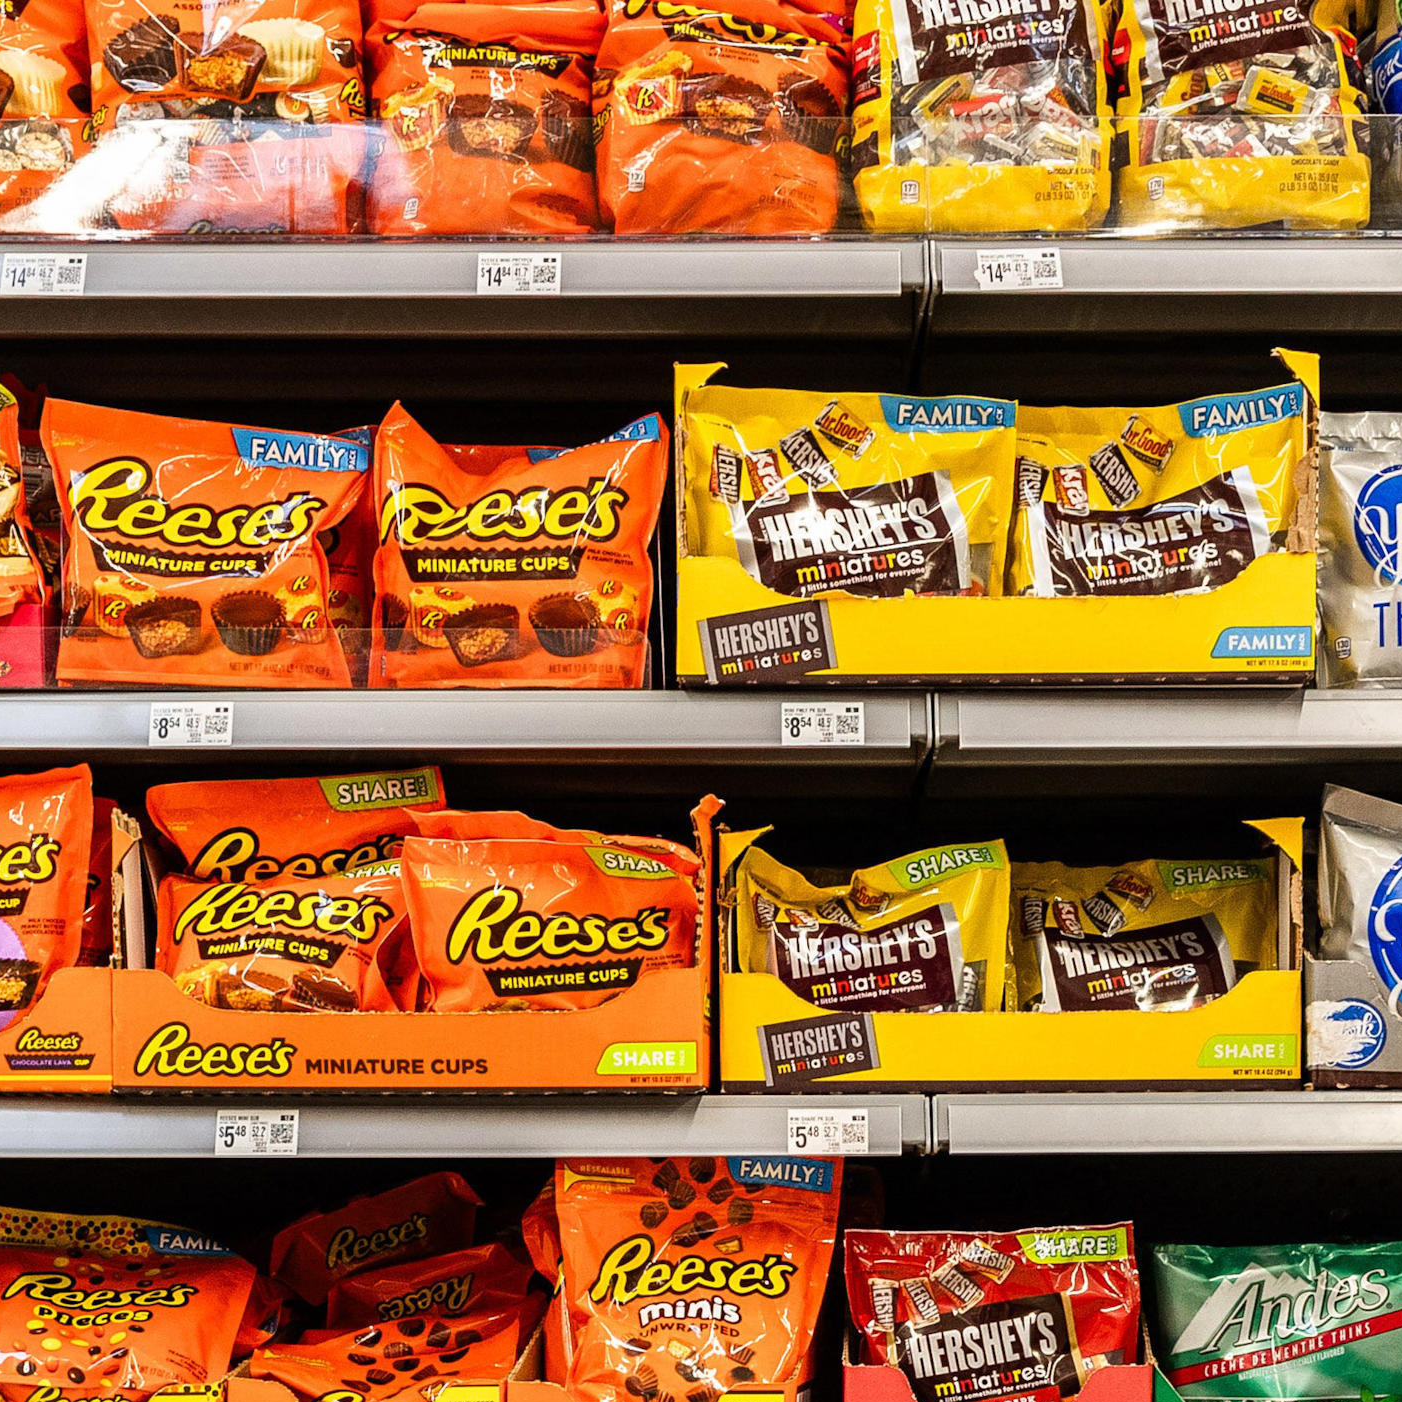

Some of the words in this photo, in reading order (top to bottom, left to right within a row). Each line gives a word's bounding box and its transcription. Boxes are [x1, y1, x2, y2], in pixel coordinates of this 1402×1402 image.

[946, 17, 1065, 50] miniatures
[434, 47, 516, 65] MINIATURE
[519, 53, 557, 70] CUPS
[251, 438, 347, 470] FAMILY
[69, 458, 325, 546] Reese's
[1064, 499, 1233, 560] HERSHEY'S
[107, 549, 206, 572] MINIATURE
[210, 557, 256, 571] CUPS
[417, 558, 520, 573] MINIATURE
[525, 556, 569, 571] CUPS
[715, 612, 819, 660] HERSHEY'S
[721, 647, 822, 676] miniatures
[338, 779, 416, 802] SHARE
[448, 886, 670, 962] Reese's
[790, 919, 936, 979] HERSHEY'S
[812, 968, 923, 999] miniatures
[772, 1022, 863, 1060] HERSHEY'S
[306, 1058, 426, 1075] MINIATURE
[430, 1058, 488, 1074] CUPS
[613, 1050, 676, 1066] SHARE
[777, 1050, 864, 1075] miniatures
[590, 1232, 796, 1302] Reese's
[638, 1298, 742, 1326] minis
[1206, 1268, 1390, 1352] Andes
[638, 1325, 740, 1338] UNWRAPPED
[1330, 1322, 1372, 1344] THINS
[934, 1365, 1047, 1396] miniatures
